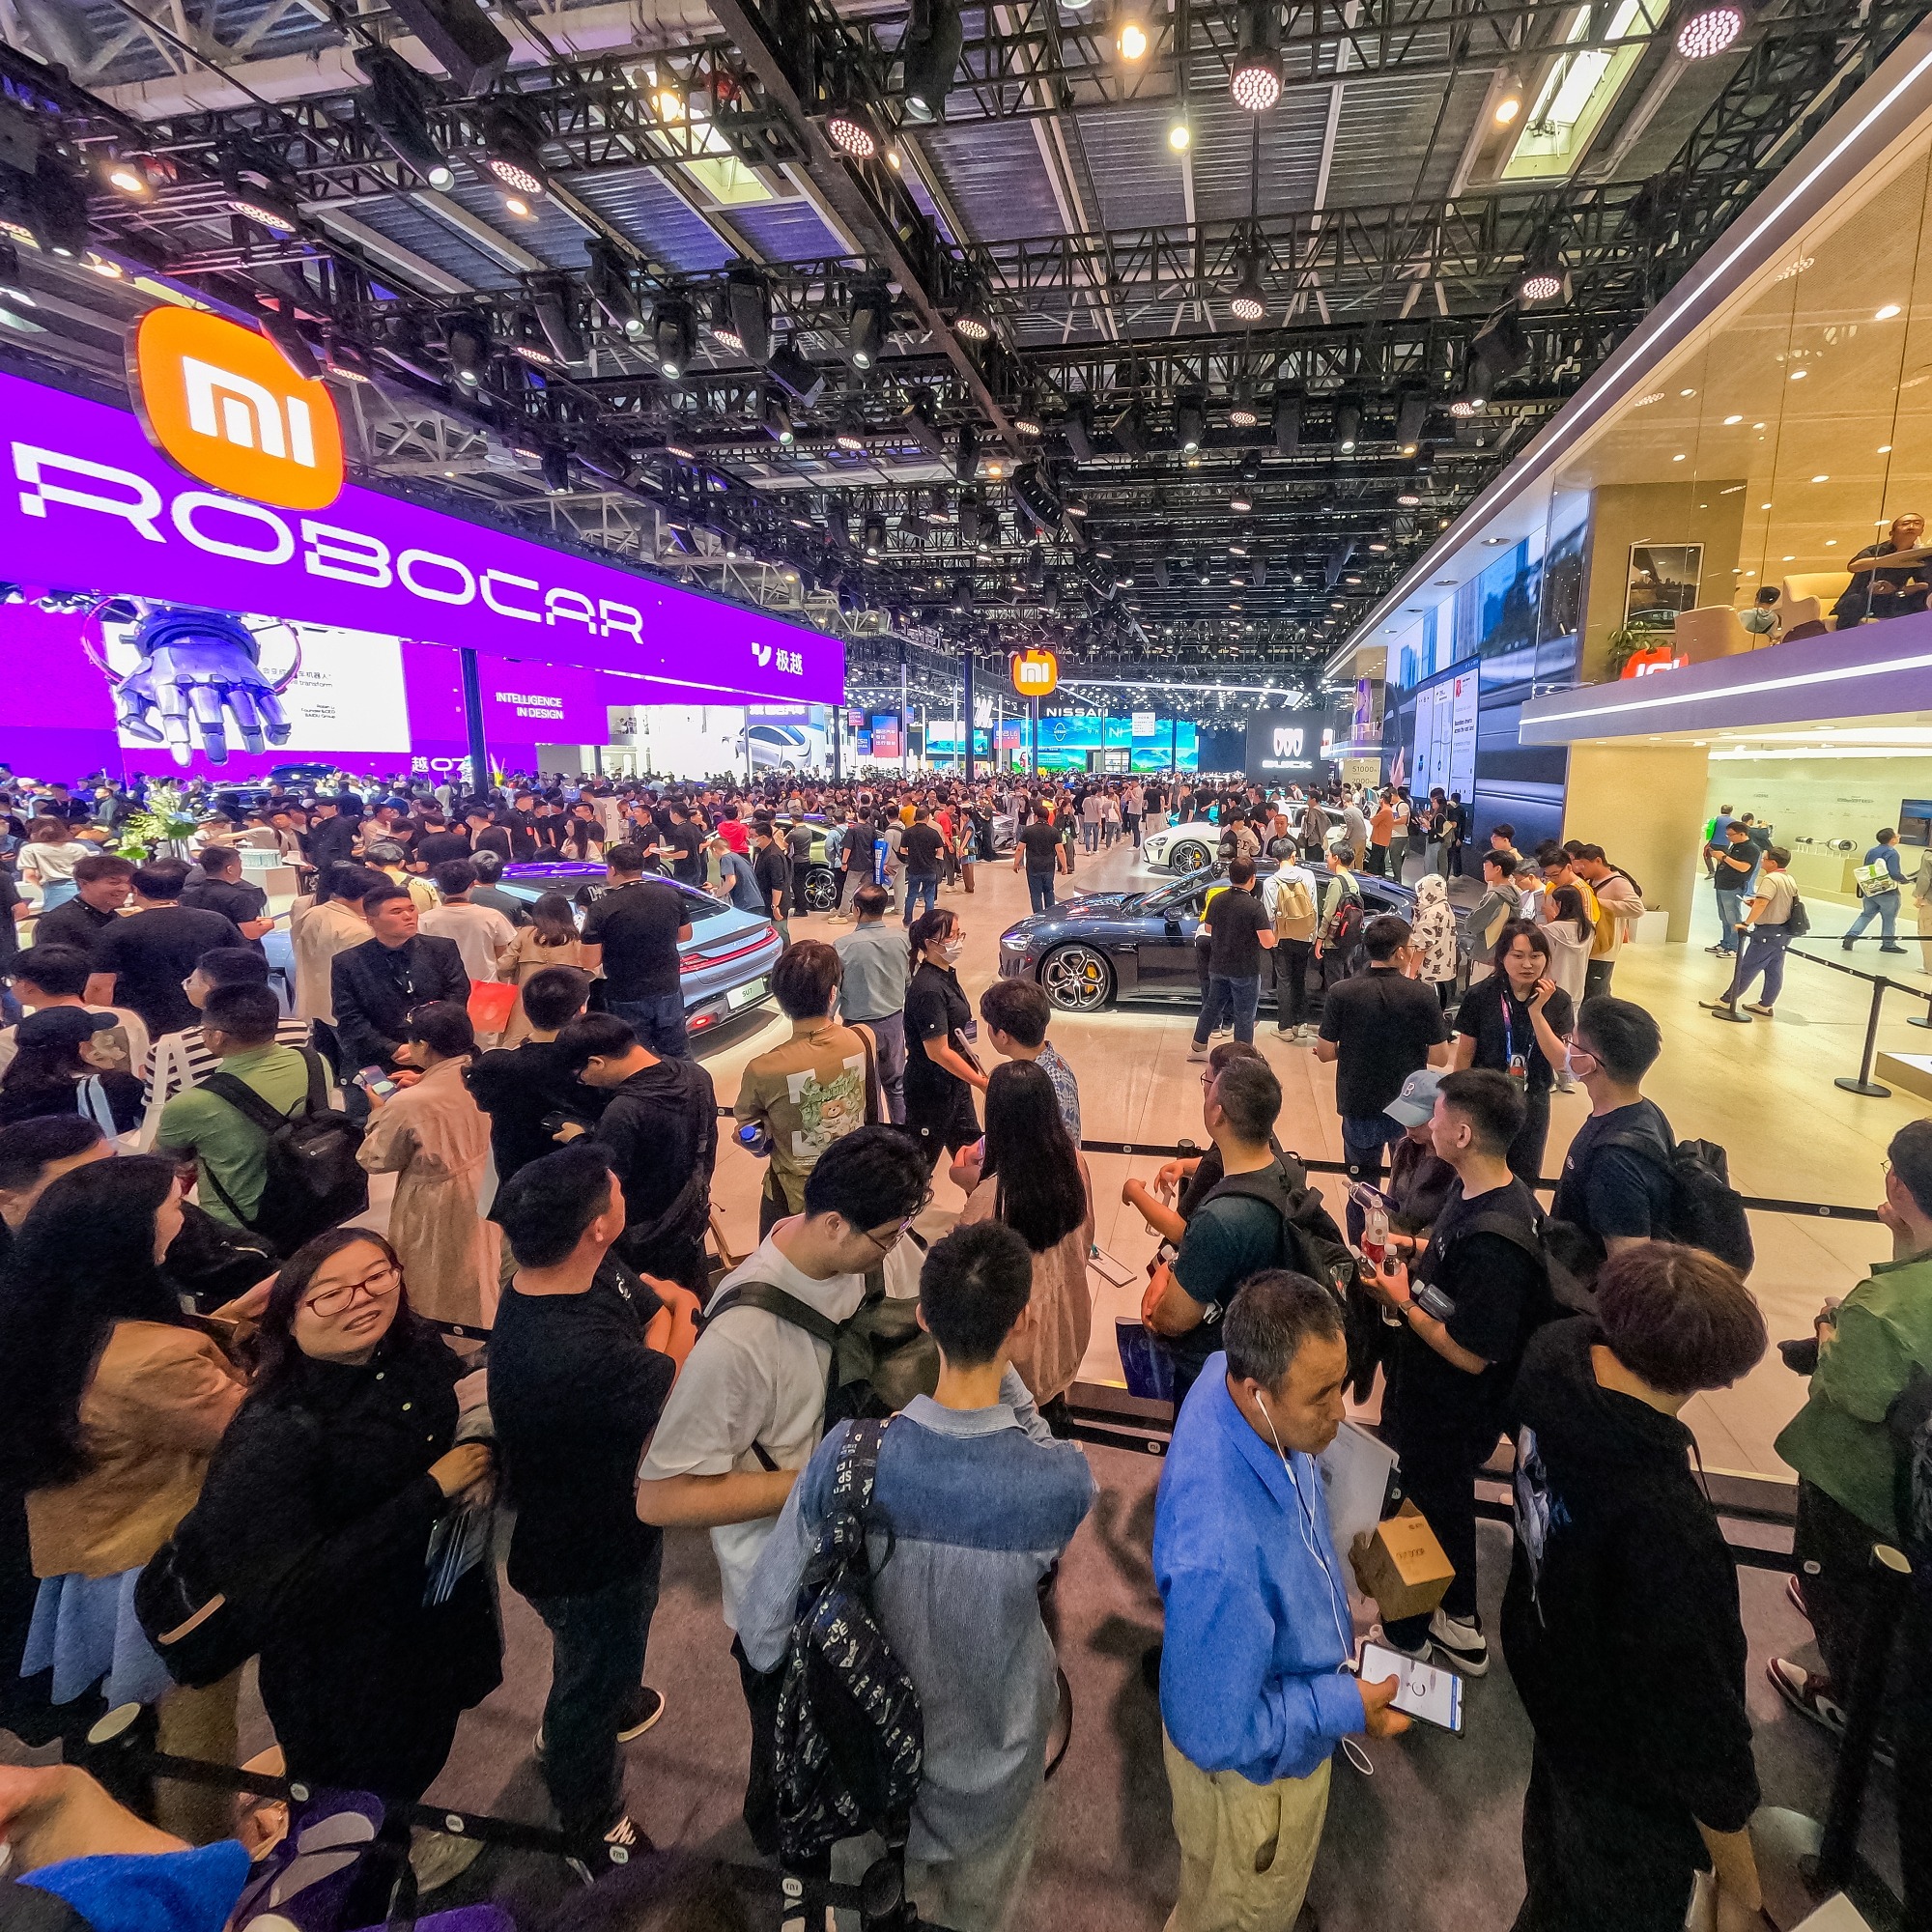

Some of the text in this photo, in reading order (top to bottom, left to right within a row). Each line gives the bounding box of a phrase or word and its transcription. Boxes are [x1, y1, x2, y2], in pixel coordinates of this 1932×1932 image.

[11, 440, 645, 645] ROBOCAR
[776, 647, 804, 676] 极越
[496, 692, 563, 708] INTELLIGENCE
[517, 706, 564, 720] IN DESIGN
[1046, 706, 1109, 718] NISSAN
[741, 987, 753, 998] SU7
[1402, 1082, 1416, 1097] B
